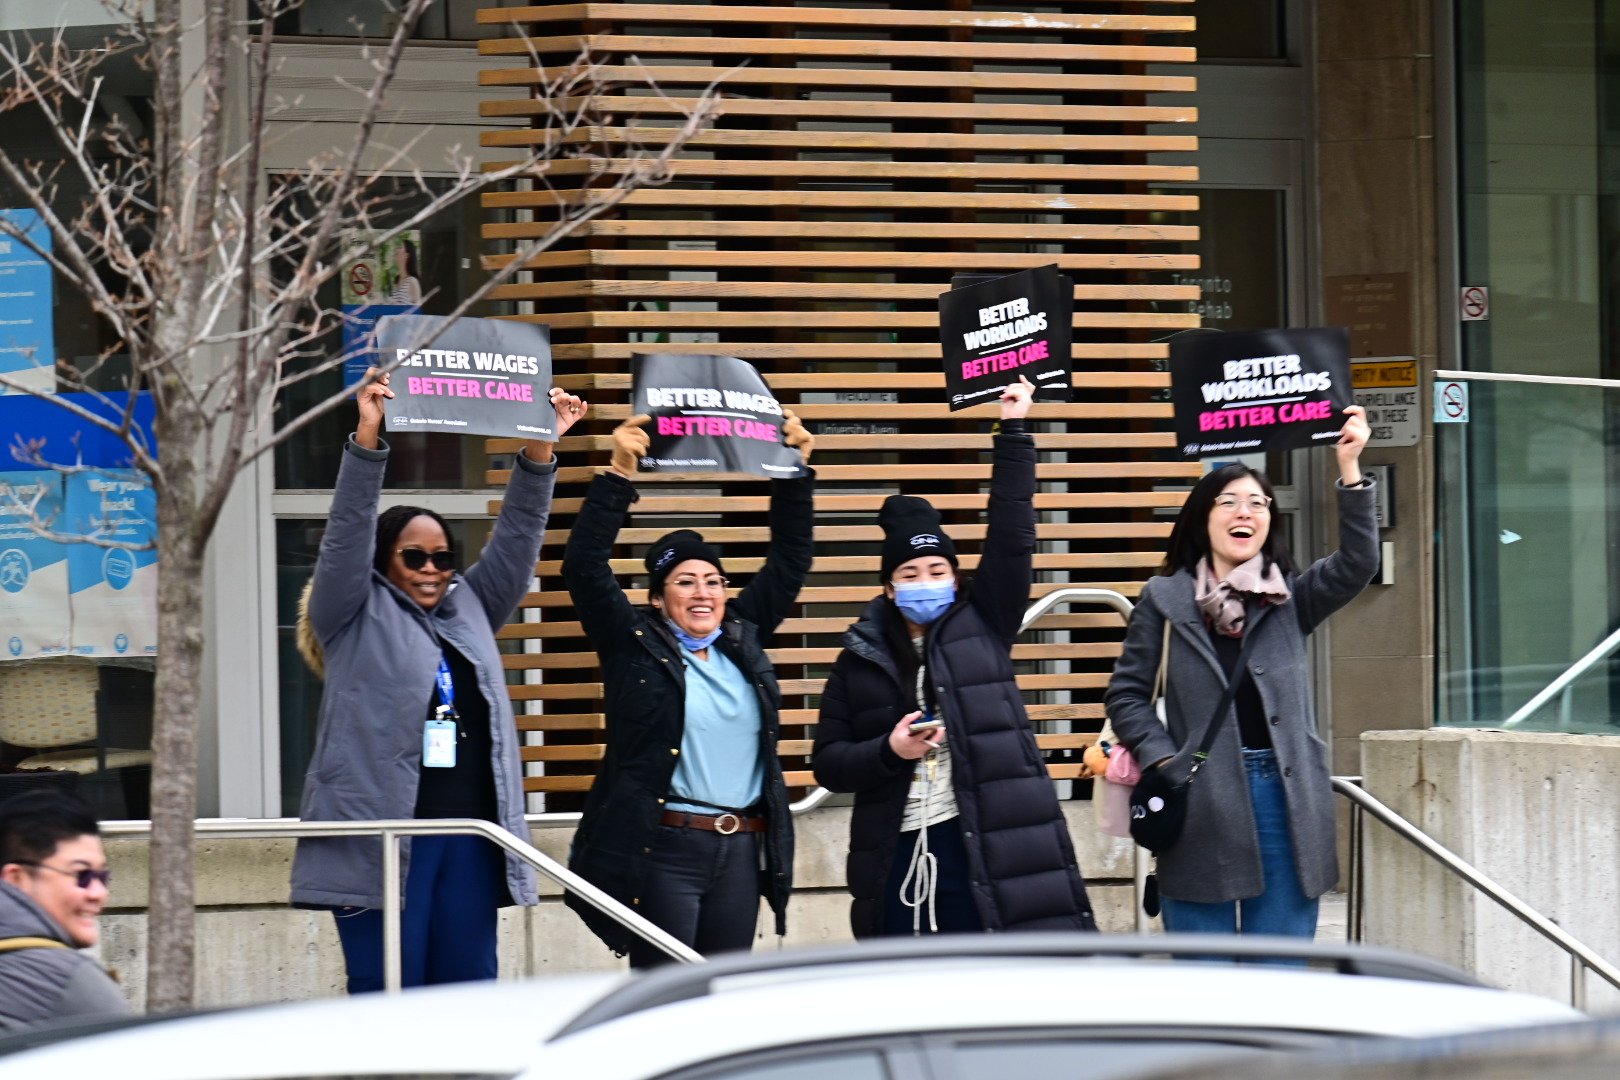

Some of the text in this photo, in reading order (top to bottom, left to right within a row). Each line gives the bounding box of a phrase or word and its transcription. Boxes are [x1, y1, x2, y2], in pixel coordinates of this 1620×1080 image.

[978, 297, 1030, 327] BETTER
[963, 311, 1048, 351] WORKLOADS
[396, 348, 470, 370] BETTER
[472, 351, 539, 375] WAGES
[961, 350, 1020, 380] BETTER
[1019, 340, 1050, 365] CARE
[1222, 354, 1302, 381] BETTER
[1200, 371, 1332, 404] WORKLOADS
[1380, 366, 1412, 382] NOTICE
[407, 376, 533, 403] BETTER CARE
[646, 387, 783, 416] BETTER WAGES
[1355, 391, 1416, 407] SURVEILLANCE
[1198, 400, 1333, 432] BETTER CARE
[1381, 408, 1408, 423] THESE
[657, 416, 780, 443] BETTER CARE
